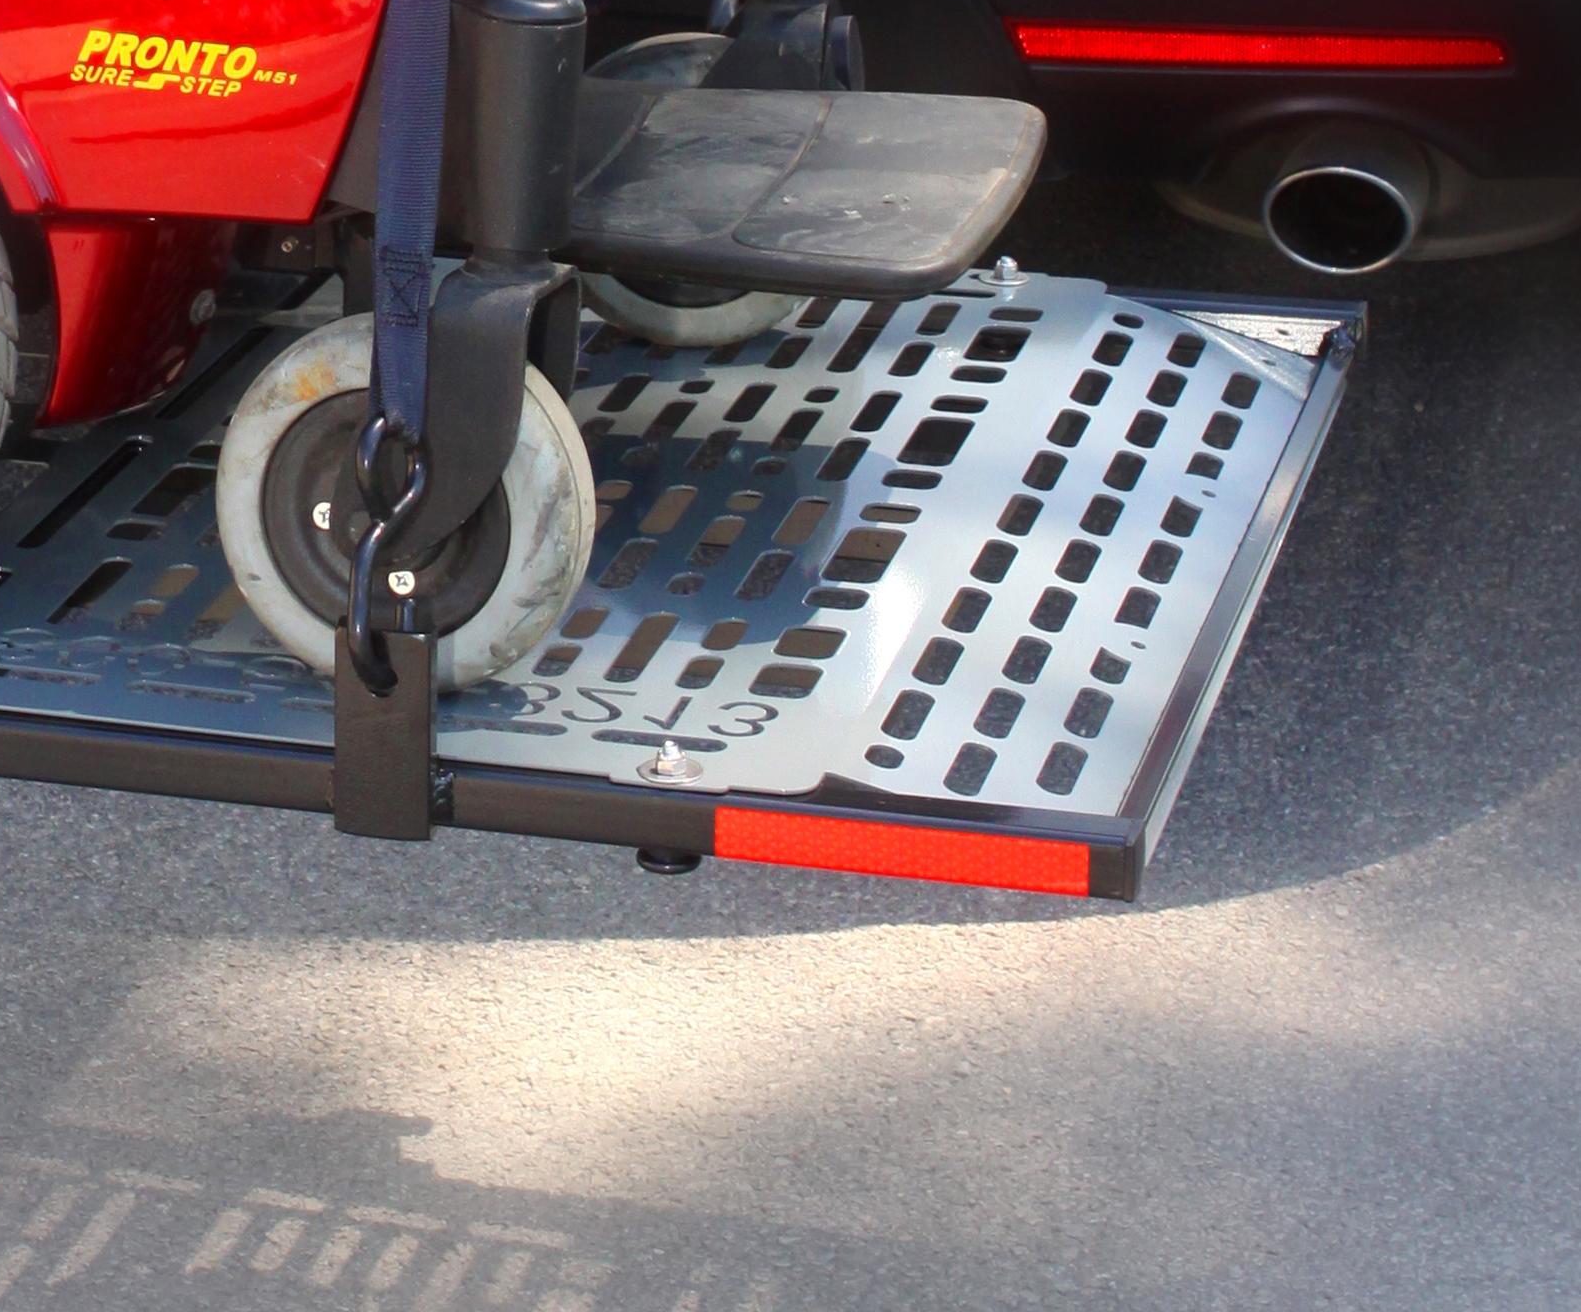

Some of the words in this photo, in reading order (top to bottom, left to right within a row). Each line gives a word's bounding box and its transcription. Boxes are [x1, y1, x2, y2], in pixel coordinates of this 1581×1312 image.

[70, 63, 135, 87] SURE
[179, 75, 242, 98] STEP
[77, 29, 258, 80] PRONTO
[253, 70, 298, 86] M51
